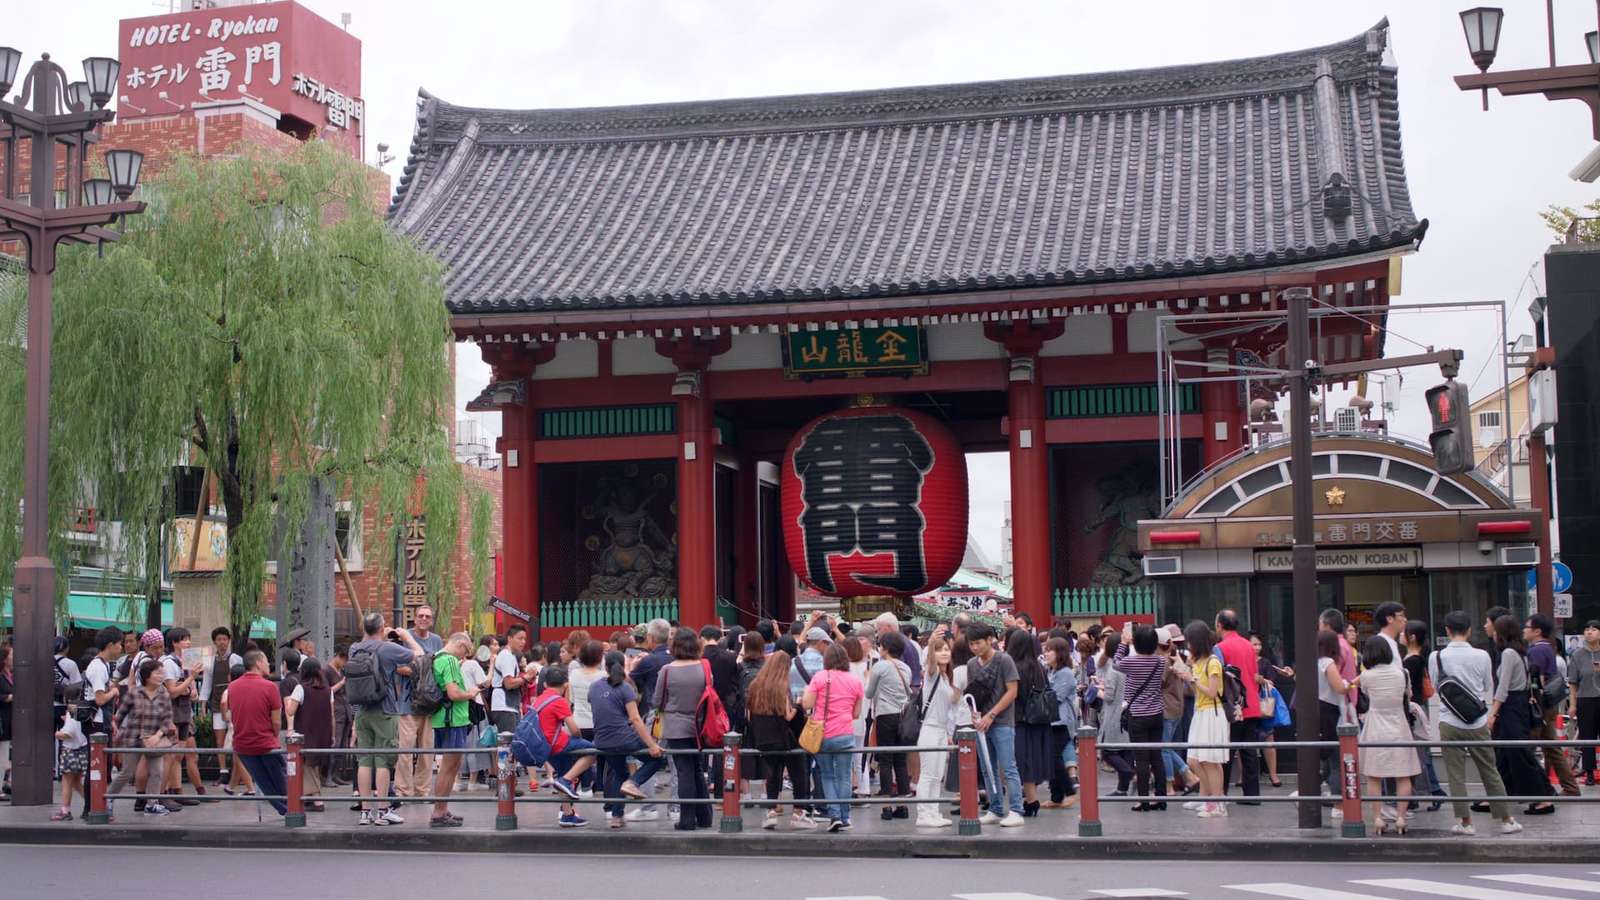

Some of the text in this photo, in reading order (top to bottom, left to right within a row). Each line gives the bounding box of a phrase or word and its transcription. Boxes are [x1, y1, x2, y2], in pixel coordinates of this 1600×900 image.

[207, 15, 279, 42] Ryokan
[793, 415, 935, 593] 雷門
[1328, 521, 1418, 542] 雷門交番
[1267, 552, 1409, 567] KAMRIMON KOBAN
